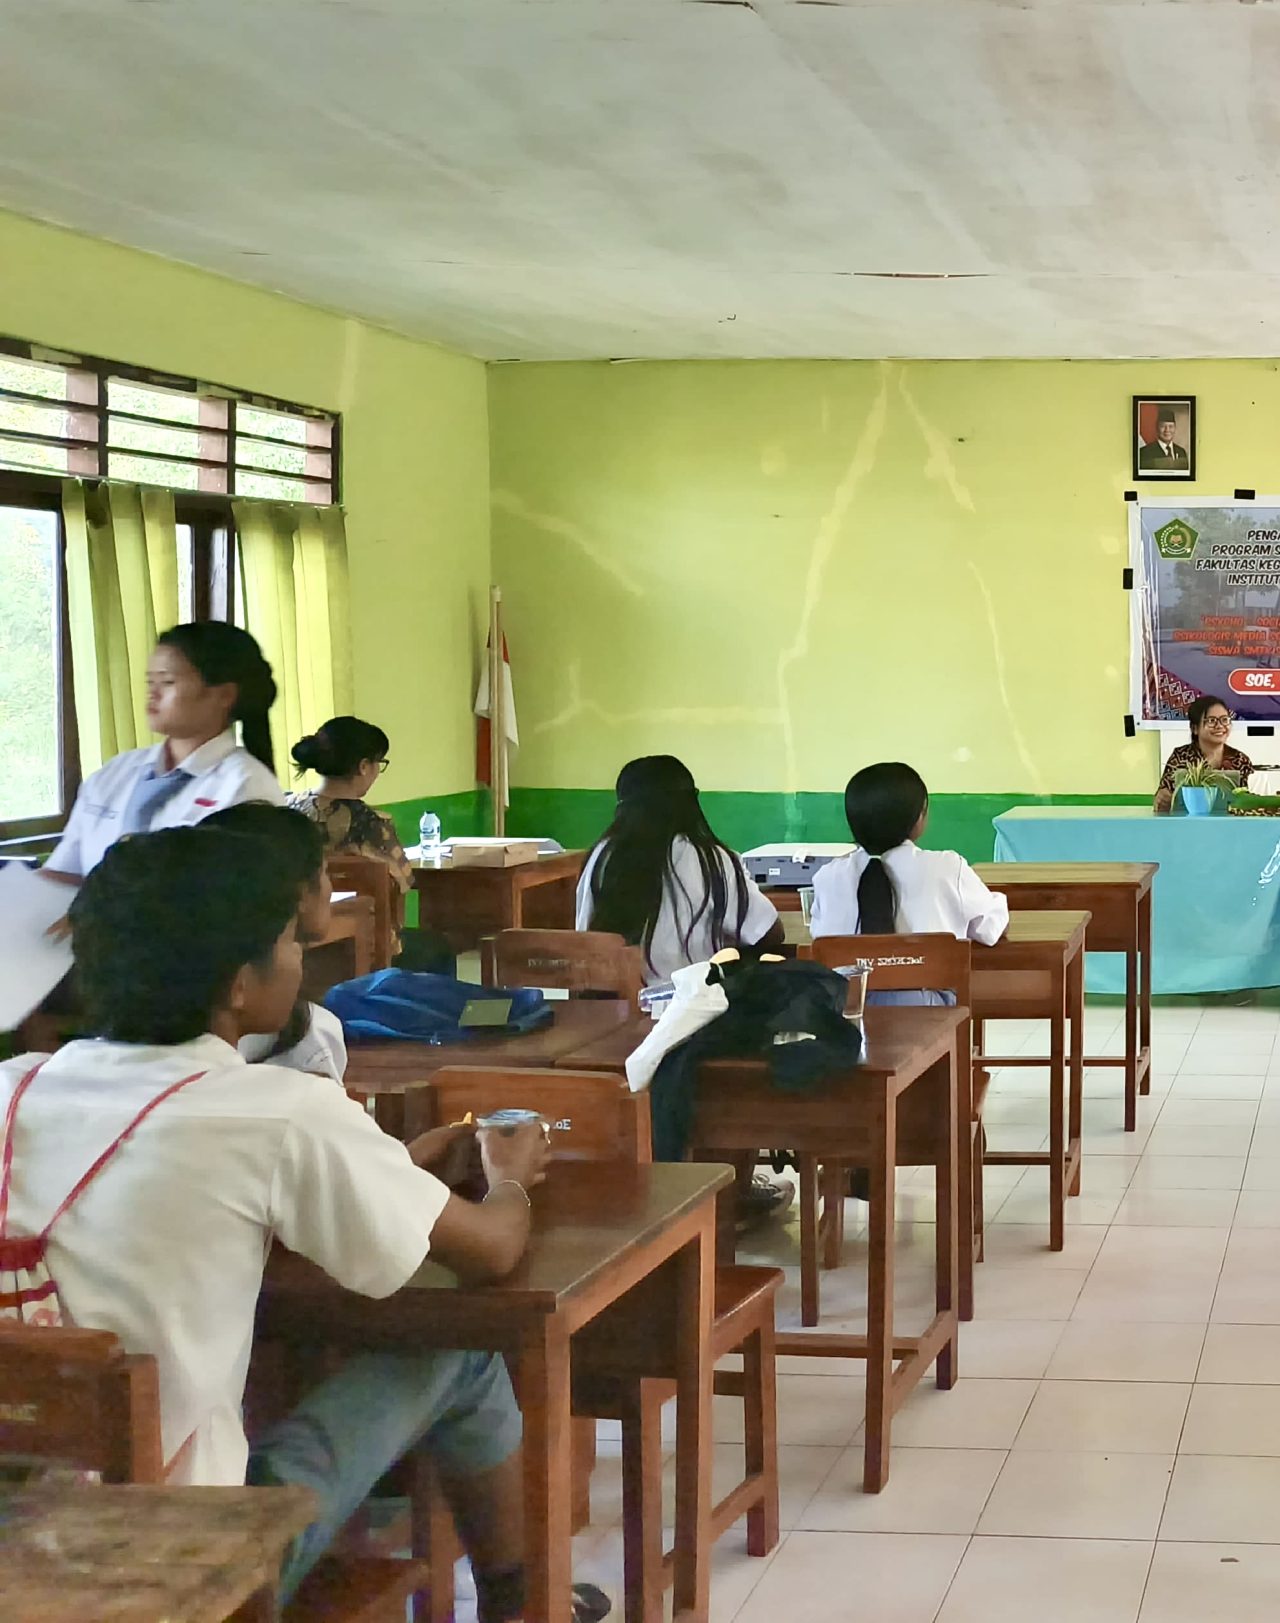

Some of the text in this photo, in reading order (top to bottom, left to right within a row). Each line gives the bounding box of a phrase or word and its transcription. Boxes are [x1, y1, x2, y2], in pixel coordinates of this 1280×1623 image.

[1211, 544, 1271, 556] PROGRAM
[1196, 559, 1256, 570] FAKULTAS
[1228, 574, 1280, 585] INSTITUT
[1232, 631, 1266, 641] MEDIA
[1208, 646, 1241, 656] SISWA
[1244, 673, 1275, 689] SOE,
